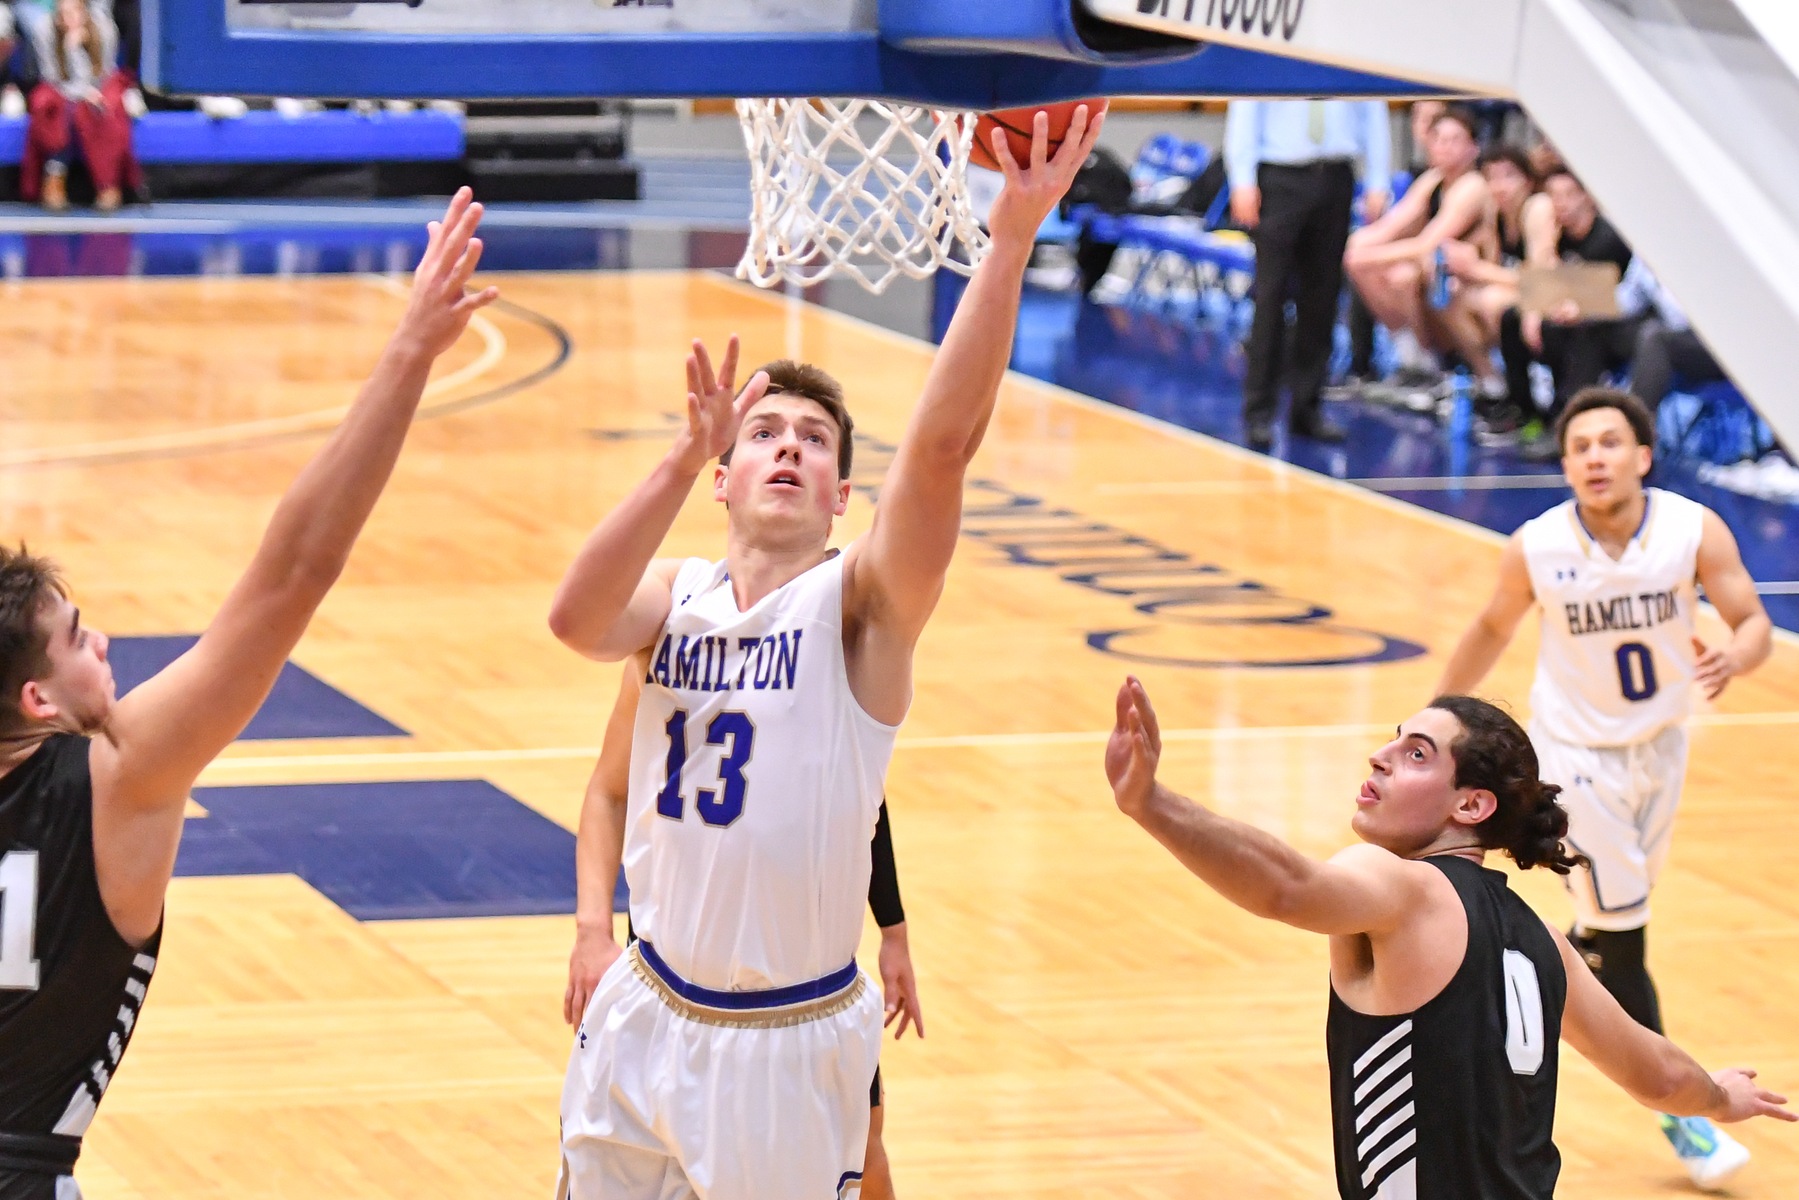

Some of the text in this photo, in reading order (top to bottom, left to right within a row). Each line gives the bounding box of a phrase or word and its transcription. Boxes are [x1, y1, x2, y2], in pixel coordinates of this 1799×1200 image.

[645, 629, 803, 692] AMILTON
[1615, 642, 1659, 702] 0
[656, 706, 757, 829] 13
[1503, 947, 1545, 1076] 0
